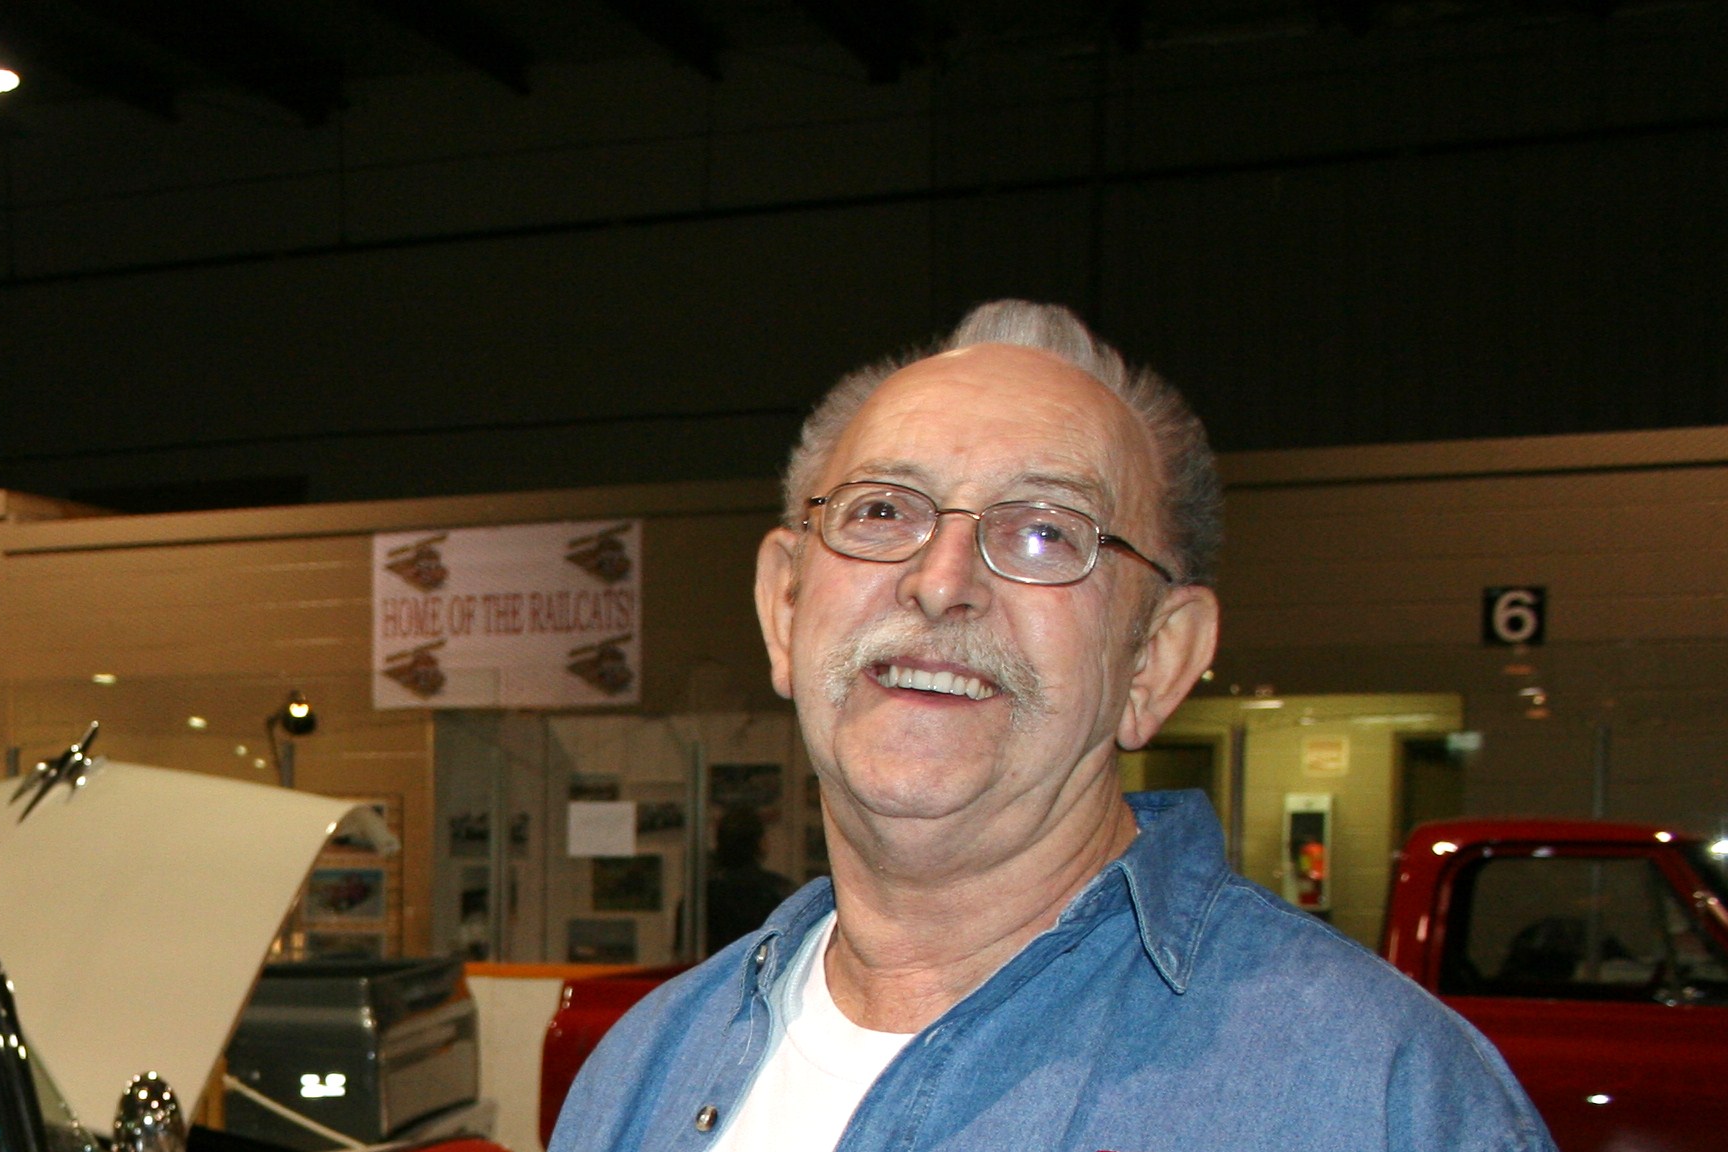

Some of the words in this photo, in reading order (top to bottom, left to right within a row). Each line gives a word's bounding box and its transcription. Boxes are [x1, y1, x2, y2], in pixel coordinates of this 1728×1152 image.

[382, 596, 442, 638] HOME
[447, 595, 478, 636] OF
[481, 592, 524, 635] THE
[1493, 590, 1538, 641] 6
